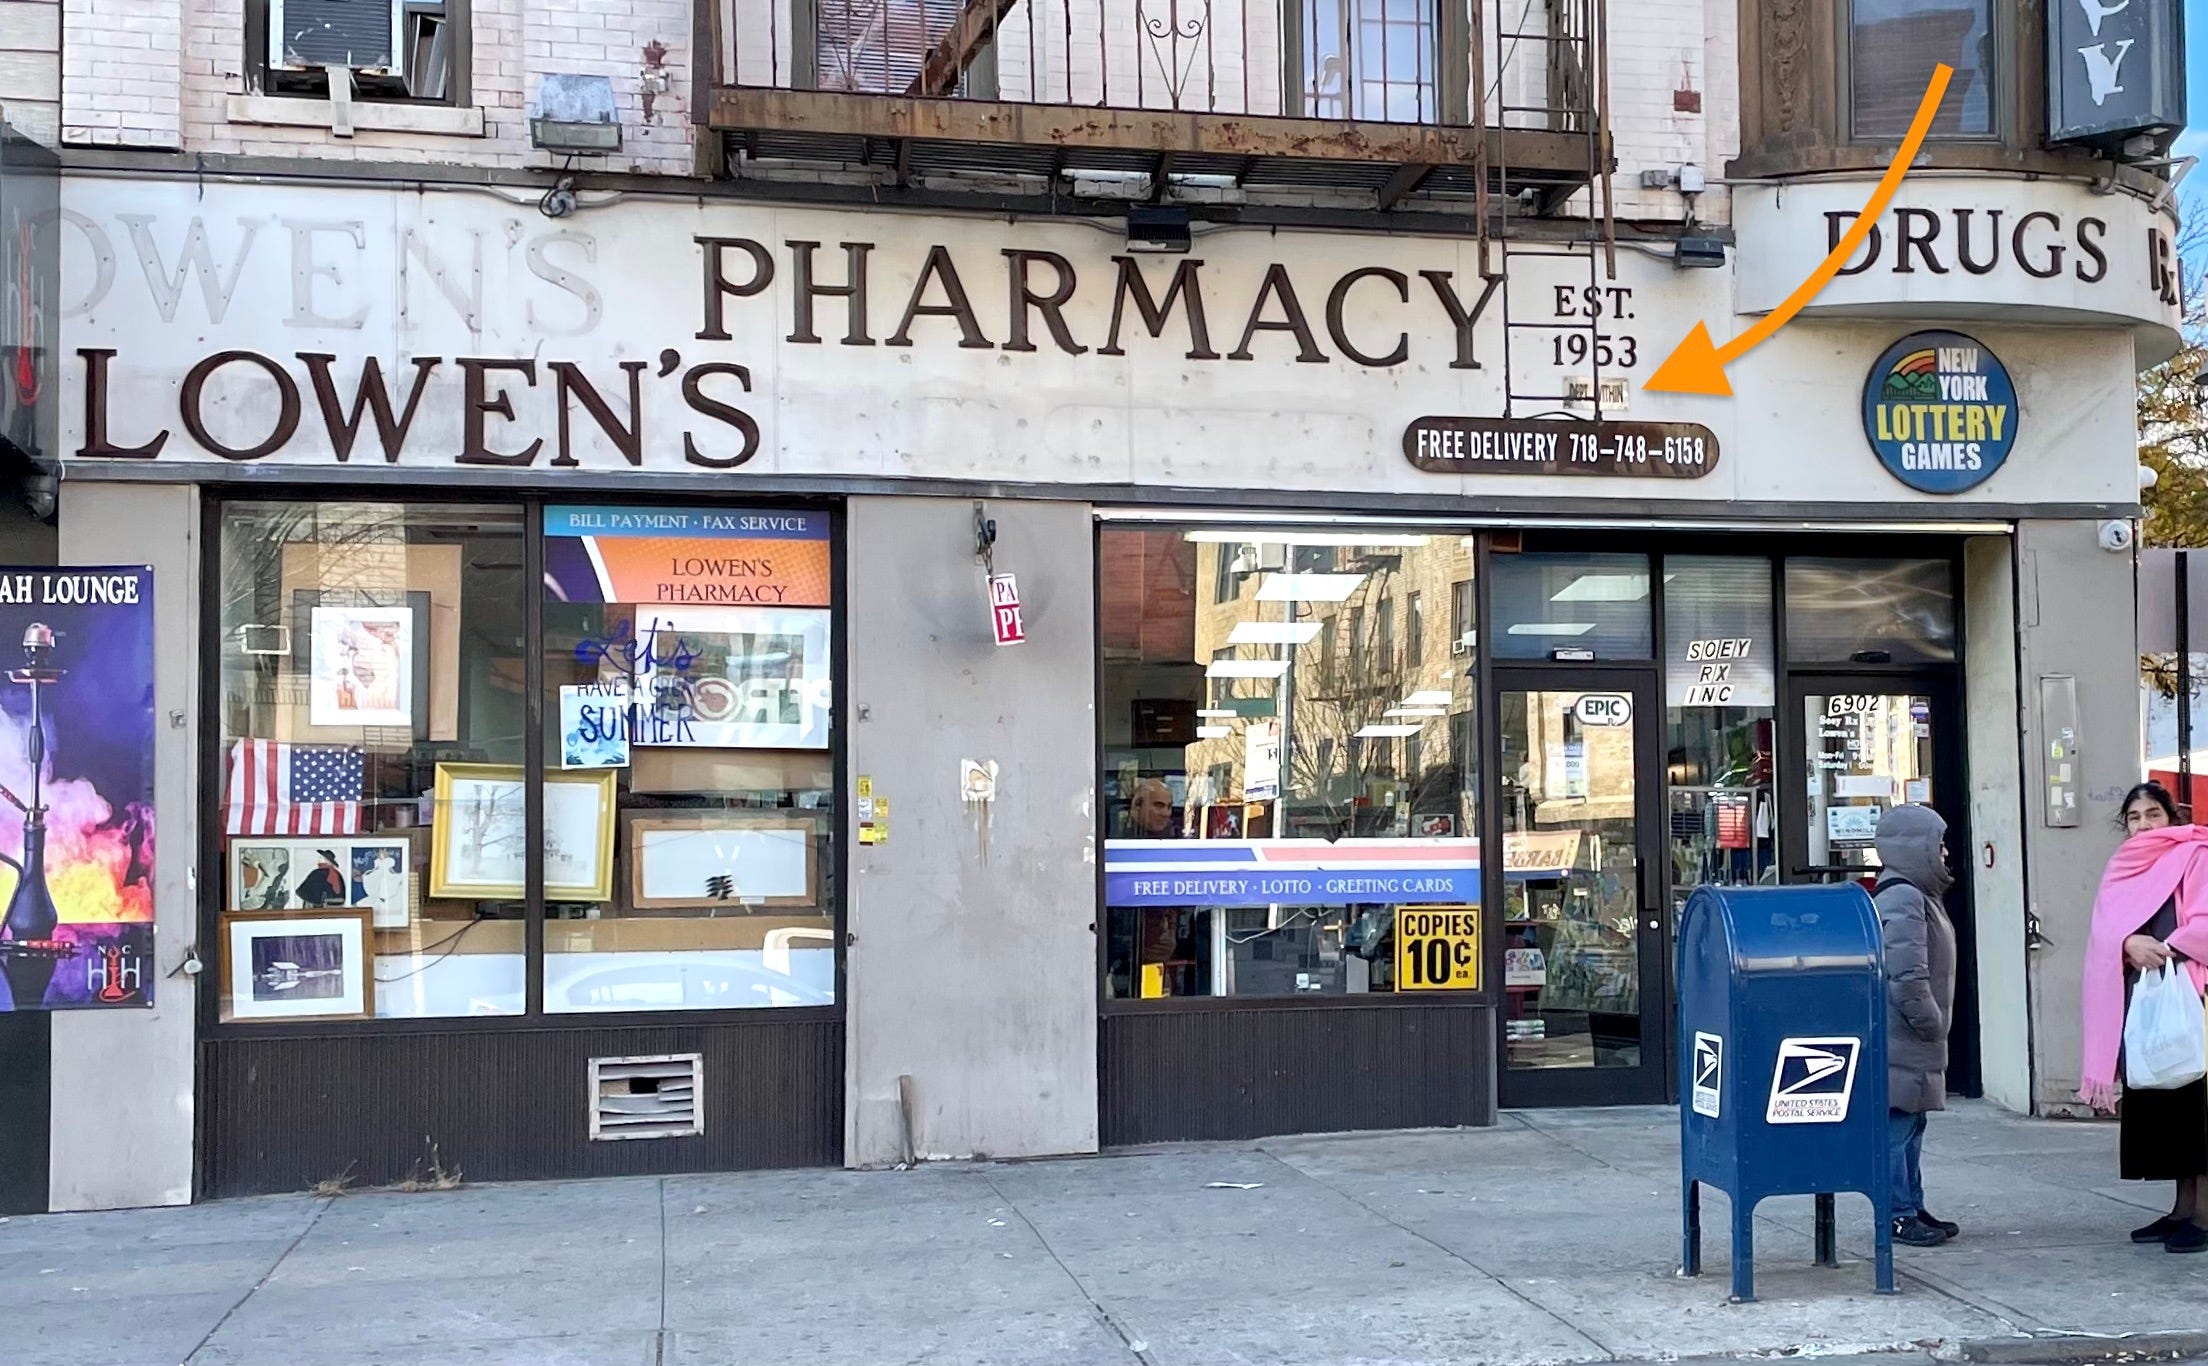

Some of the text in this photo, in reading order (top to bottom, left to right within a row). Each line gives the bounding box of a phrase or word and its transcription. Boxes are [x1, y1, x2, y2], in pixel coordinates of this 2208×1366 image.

[1823, 207, 2108, 284] DRUGS
[694, 235, 1505, 369] PHARMACY
[1553, 285, 1635, 319] EST.
[1553, 333, 1638, 368] 1953
[1938, 347, 1978, 373] NEW
[1938, 376, 1988, 401] YORK
[75, 347, 760, 469] LOWEN'S
[1876, 404, 2007, 441] LOTTERY
[1417, 429, 1465, 459] FREE
[1470, 431, 1559, 462] DELIVERY
[1901, 442, 1983, 471] GAMES
[569, 513, 807, 532] BILL PAYMENT FAX SERVICE
[672, 558, 773, 577] LOWEN'S
[42, 575, 139, 604] LOUNGE
[657, 583, 788, 603] PHARMACY
[1689, 640, 1749, 659] SOEY
[1700, 665, 1729, 682] RX
[1689, 687, 1731, 703] INC
[1831, 695, 1879, 713] 6902
[1585, 700, 1621, 716] EPIC
[577, 703, 697, 743] SUMMER
[1134, 878, 1454, 896] FREE DELIVERY LOTTO GREETING CARDS
[1404, 914, 1475, 936] COPIES
[1772, 1109, 1804, 1117] POSTAL
[1774, 1098, 1839, 1108] UNITED STATES
